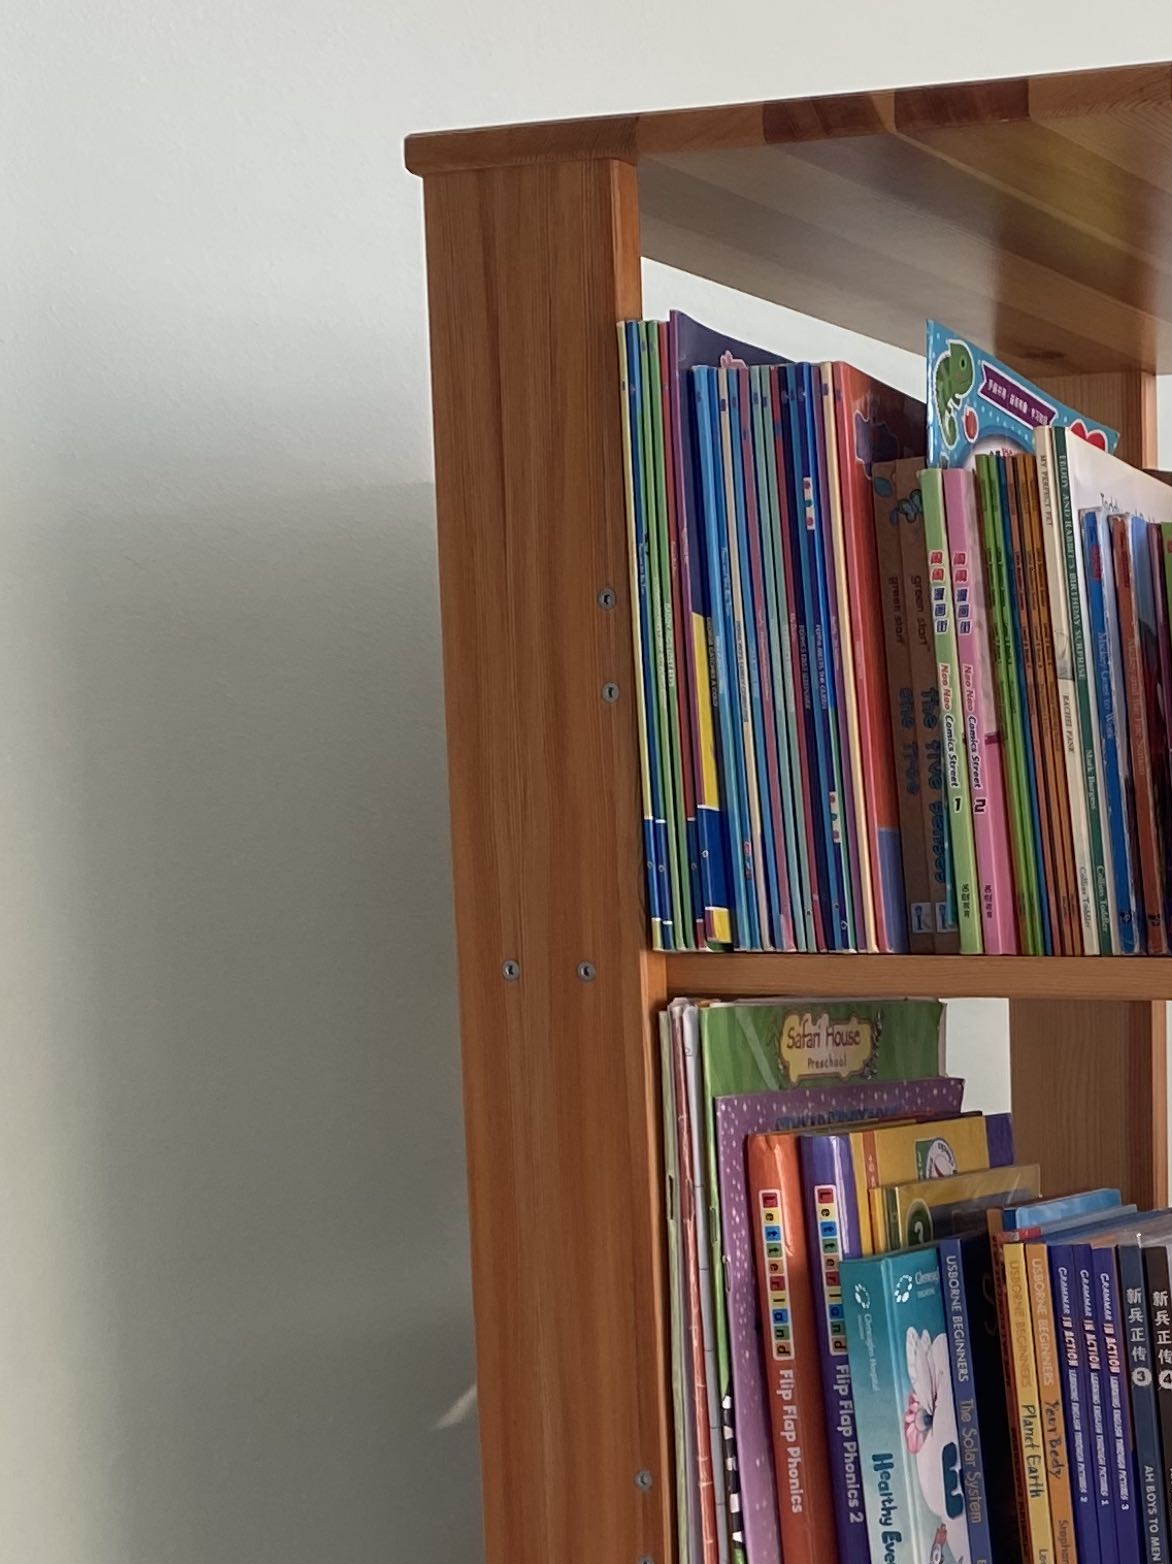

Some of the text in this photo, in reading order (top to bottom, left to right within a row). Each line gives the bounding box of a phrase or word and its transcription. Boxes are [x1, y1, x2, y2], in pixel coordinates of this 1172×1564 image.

[1040, 455, 1051, 508] MY PERFECT
[912, 576, 929, 646] green start
[1062, 493, 1086, 680] AND BIRTHDAY SURPRISE
[940, 664, 960, 788] Nao Nao Comics Street
[964, 666, 982, 788] Nao Nao Comics Street
[1063, 695, 1073, 727] RACHEL
[1086, 750, 1096, 771] Mark
[1079, 866, 1092, 929] Collins Toddler
[1097, 865, 1111, 932] Collins Toddler
[787, 1020, 861, 1049] Safari House
[808, 1052, 847, 1069] Preschool
[1032, 1259, 1053, 1385] USBORNE BEGINNERS
[1064, 1330, 1079, 1367] ACTION
[1085, 1333, 1101, 1370] ACTION
[1104, 1336, 1120, 1374] ACTION
[946, 1255, 983, 1524] USBORNE BEGINNERS The Solar System
[776, 1370, 804, 1513] Flip Flap Phonics
[832, 1365, 863, 1523] Flip Flap Phonics 2
[1021, 1405, 1045, 1498] Planet Earth
[871, 1453, 898, 1526] Healthy
[1144, 1465, 1162, 1561] AH BOYS TO MEN
